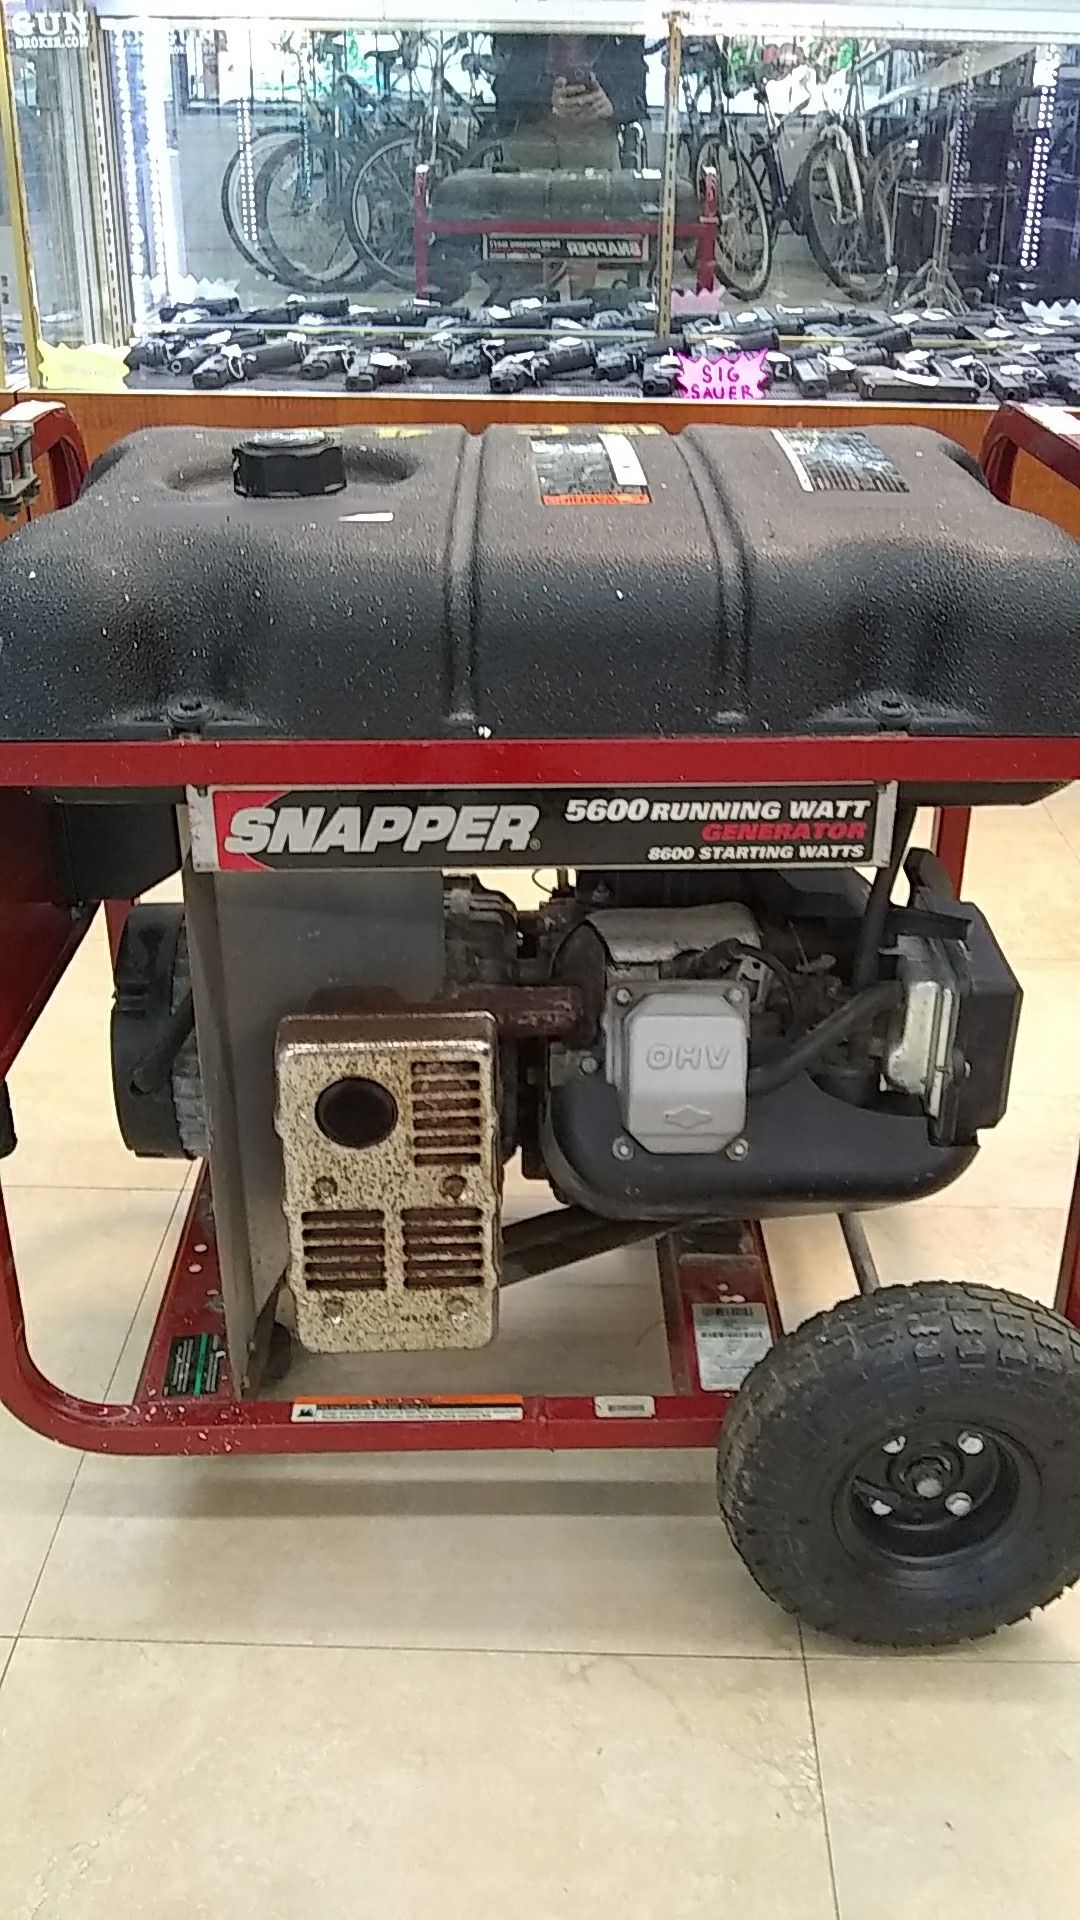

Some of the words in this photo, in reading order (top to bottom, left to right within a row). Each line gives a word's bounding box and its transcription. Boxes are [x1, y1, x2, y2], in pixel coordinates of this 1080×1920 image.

[12, 10, 88, 36] GUN
[15, 36, 88, 49] BROKER.COM
[702, 364, 740, 384] SIG
[690, 383, 754, 400] SAUER
[564, 797, 650, 822] 5600
[651, 801, 782, 821] RUNNING
[789, 799, 871, 820] WATT
[224, 805, 540, 854] SNAPPER
[702, 822, 868, 841] GENERATOR
[647, 845, 695, 861] 8600
[698, 845, 794, 860] STARTING
[798, 844, 866, 860] WATTS
[646, 1043, 731, 1070] OHV
